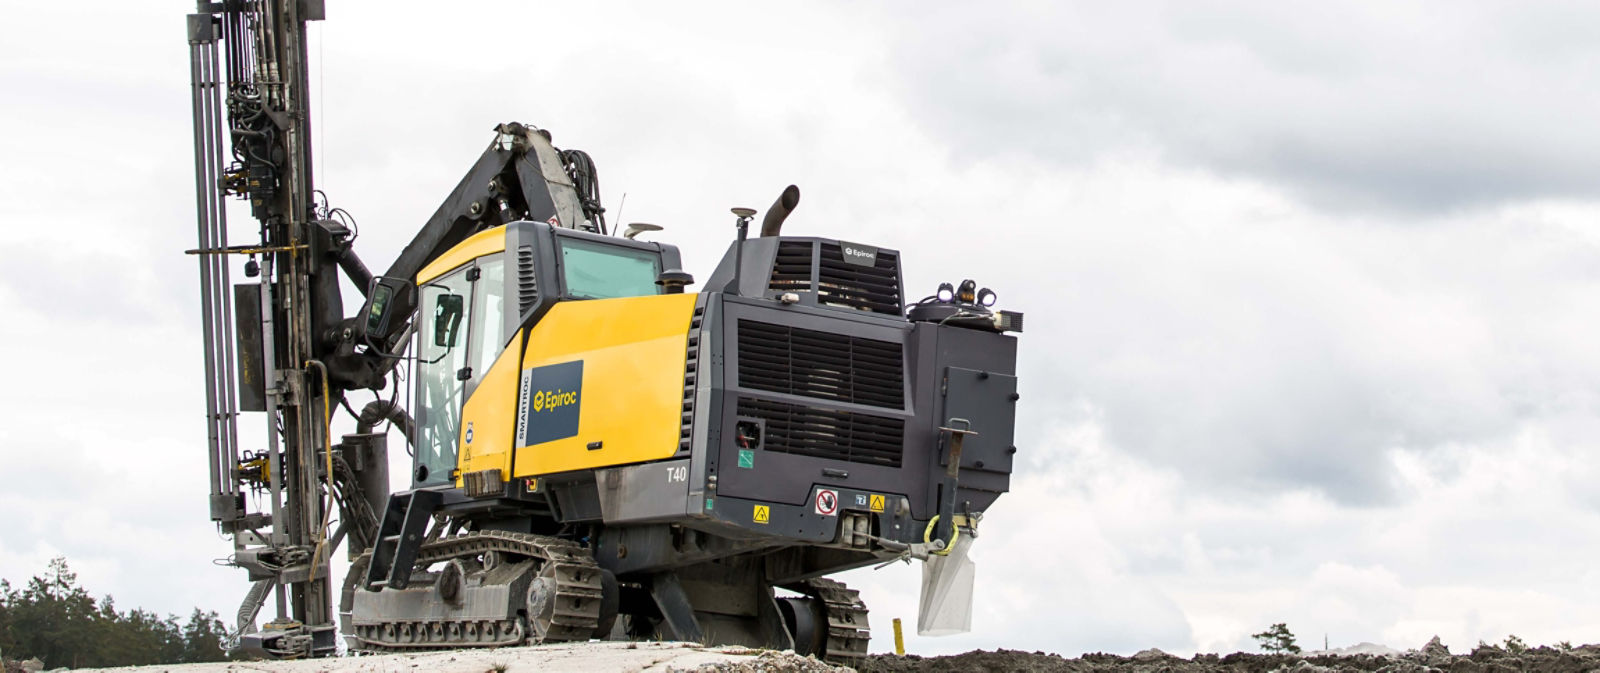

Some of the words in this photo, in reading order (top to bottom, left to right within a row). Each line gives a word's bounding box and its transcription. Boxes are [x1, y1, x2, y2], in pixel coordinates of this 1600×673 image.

[853, 249, 875, 258] Epiroc
[519, 376, 529, 439] SMARTROC
[545, 388, 577, 412] Epiroc
[666, 466, 687, 483] T40
